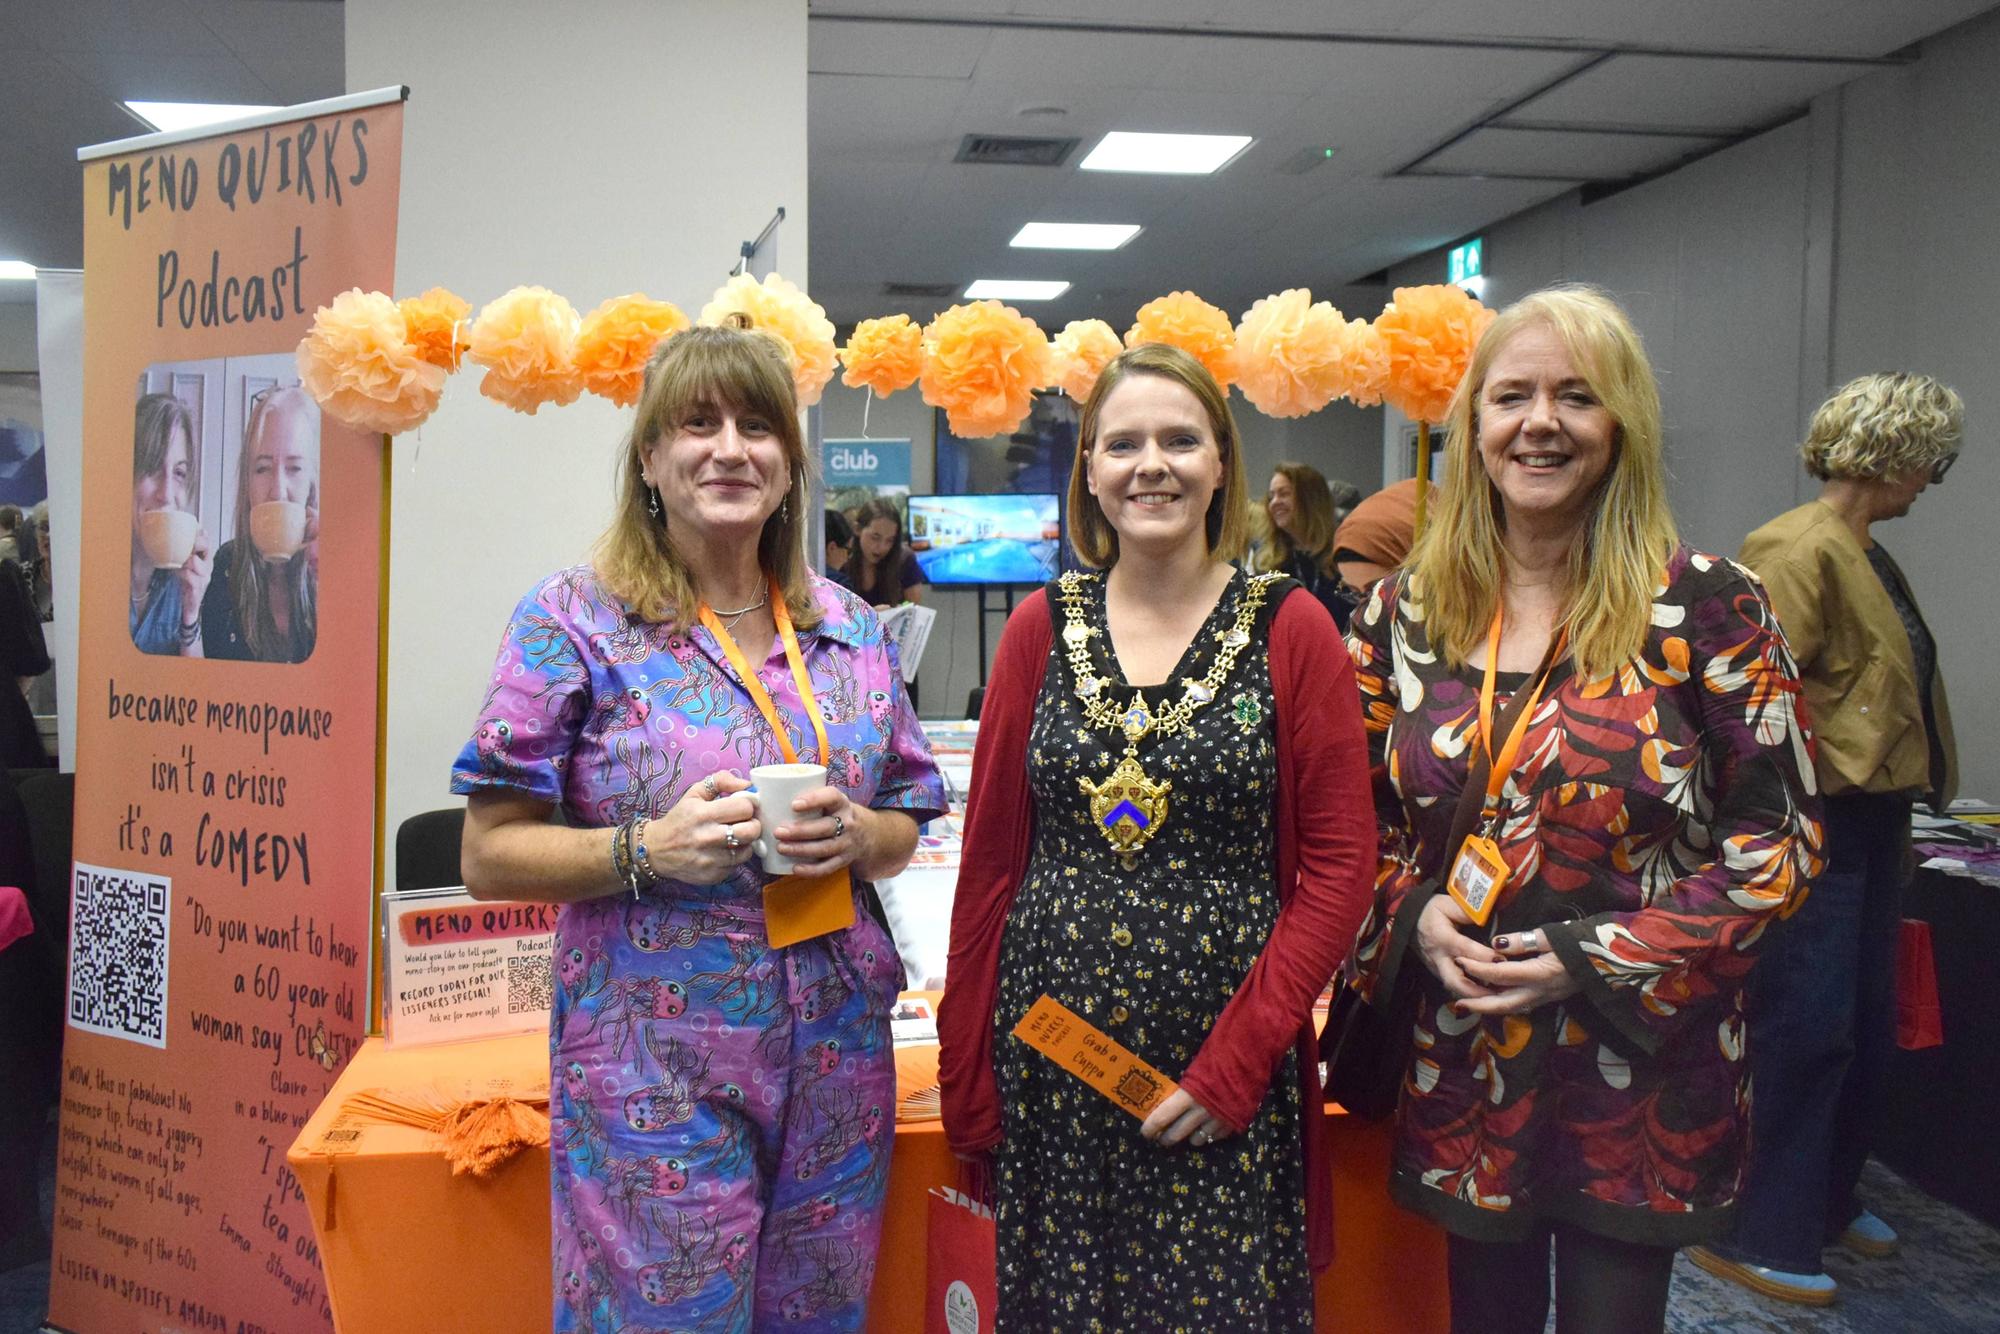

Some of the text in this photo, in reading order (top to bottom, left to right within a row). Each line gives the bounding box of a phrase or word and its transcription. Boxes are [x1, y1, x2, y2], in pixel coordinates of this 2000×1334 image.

[108, 118, 368, 231] MENO QUIRKS
[157, 226, 308, 329] Podcast
[830, 448, 879, 471] club
[109, 678, 332, 755] because menopause
[152, 745, 286, 808] isn't a crisis
[119, 803, 311, 887] it's a COMEDY
[219, 920, 248, 954] you
[255, 914, 299, 953] want
[306, 917, 323, 957] to
[329, 922, 359, 969] hear
[416, 904, 560, 940] MENO QUIRKS
[404, 952, 428, 964] Would
[430, 953, 442, 967] you
[444, 949, 456, 960] like
[458, 948, 466, 958] to
[467, 946, 480, 957] tell
[517, 936, 552, 952] Podcast
[234, 963, 354, 1023] a 60 year old
[400, 969, 506, 1002] RECORD TODAY FOR OUR
[401, 987, 491, 1017] LISTENERS SPECIAL!
[191, 1010, 243, 1045] woman
[252, 1025, 282, 1066] say
[1083, 1033, 1118, 1063] Grab a
[271, 1070, 308, 1096] Claire
[1072, 1050, 1105, 1079] Cuppa
[96, 1067, 114, 1093] this
[179, 1092, 192, 1114] No
[156, 1117, 163, 1138] &
[250, 1105, 257, 1119] a
[262, 1100, 289, 1124] blue
[96, 1128, 123, 1154] which
[128, 1146, 144, 1161] can
[147, 1147, 168, 1178] only
[173, 1152, 185, 1173] be
[97, 1157, 107, 1180] to
[145, 1176, 155, 1203] of
[158, 1179, 173, 1202] all
[219, 1213, 251, 1253] Emma
[263, 1193, 289, 1244] tea
[59, 1252, 99, 1287] LISTEN
[103, 1273, 117, 1293] ON
[143, 1237, 155, 1265] of
[157, 1237, 174, 1261] the
[177, 1246, 197, 1273] 60s
[296, 1235, 322, 1270] ou
[266, 1252, 316, 1307] Straight
